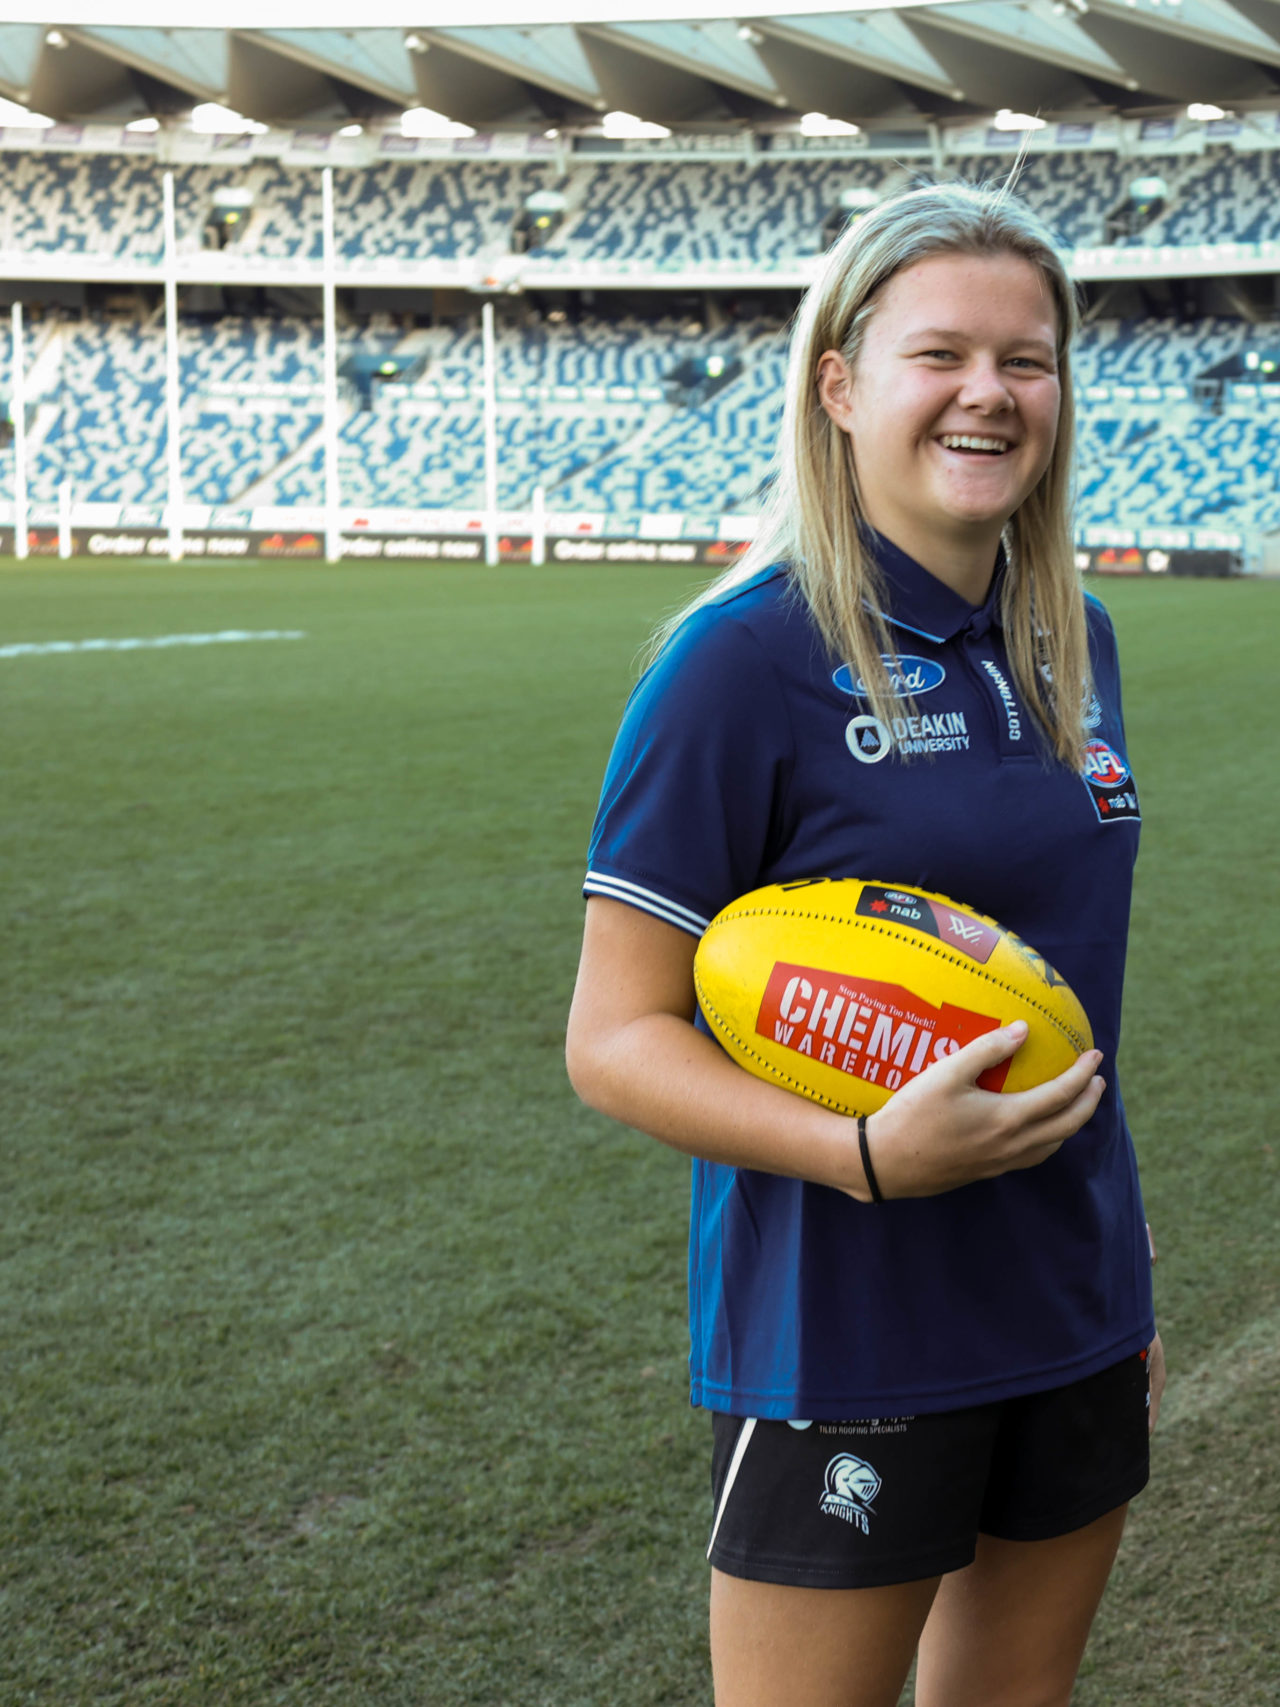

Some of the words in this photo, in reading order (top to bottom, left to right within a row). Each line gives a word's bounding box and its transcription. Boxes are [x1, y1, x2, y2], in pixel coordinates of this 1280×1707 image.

[147, 536, 206, 555] onne
[856, 660, 926, 691] Frd
[891, 712, 968, 739] DEAKIN
[898, 736, 970, 755] UNIVERSITY
[1085, 751, 1126, 776] AFL
[890, 903, 922, 920] nab
[838, 984, 858, 999] Stop
[858, 992, 887, 1012] Paying
[888, 1004, 904, 1017] Too
[904, 1011, 936, 1030] Much!!
[779, 976, 961, 1074] CHEMIS
[774, 1019, 903, 1091] WAREHO
[819, 1424, 837, 1434] TILED
[838, 1425, 868, 1435] ROOFING
[869, 1423, 908, 1435] SPECIALISTS
[820, 1503, 869, 1536] KNIGHTS
